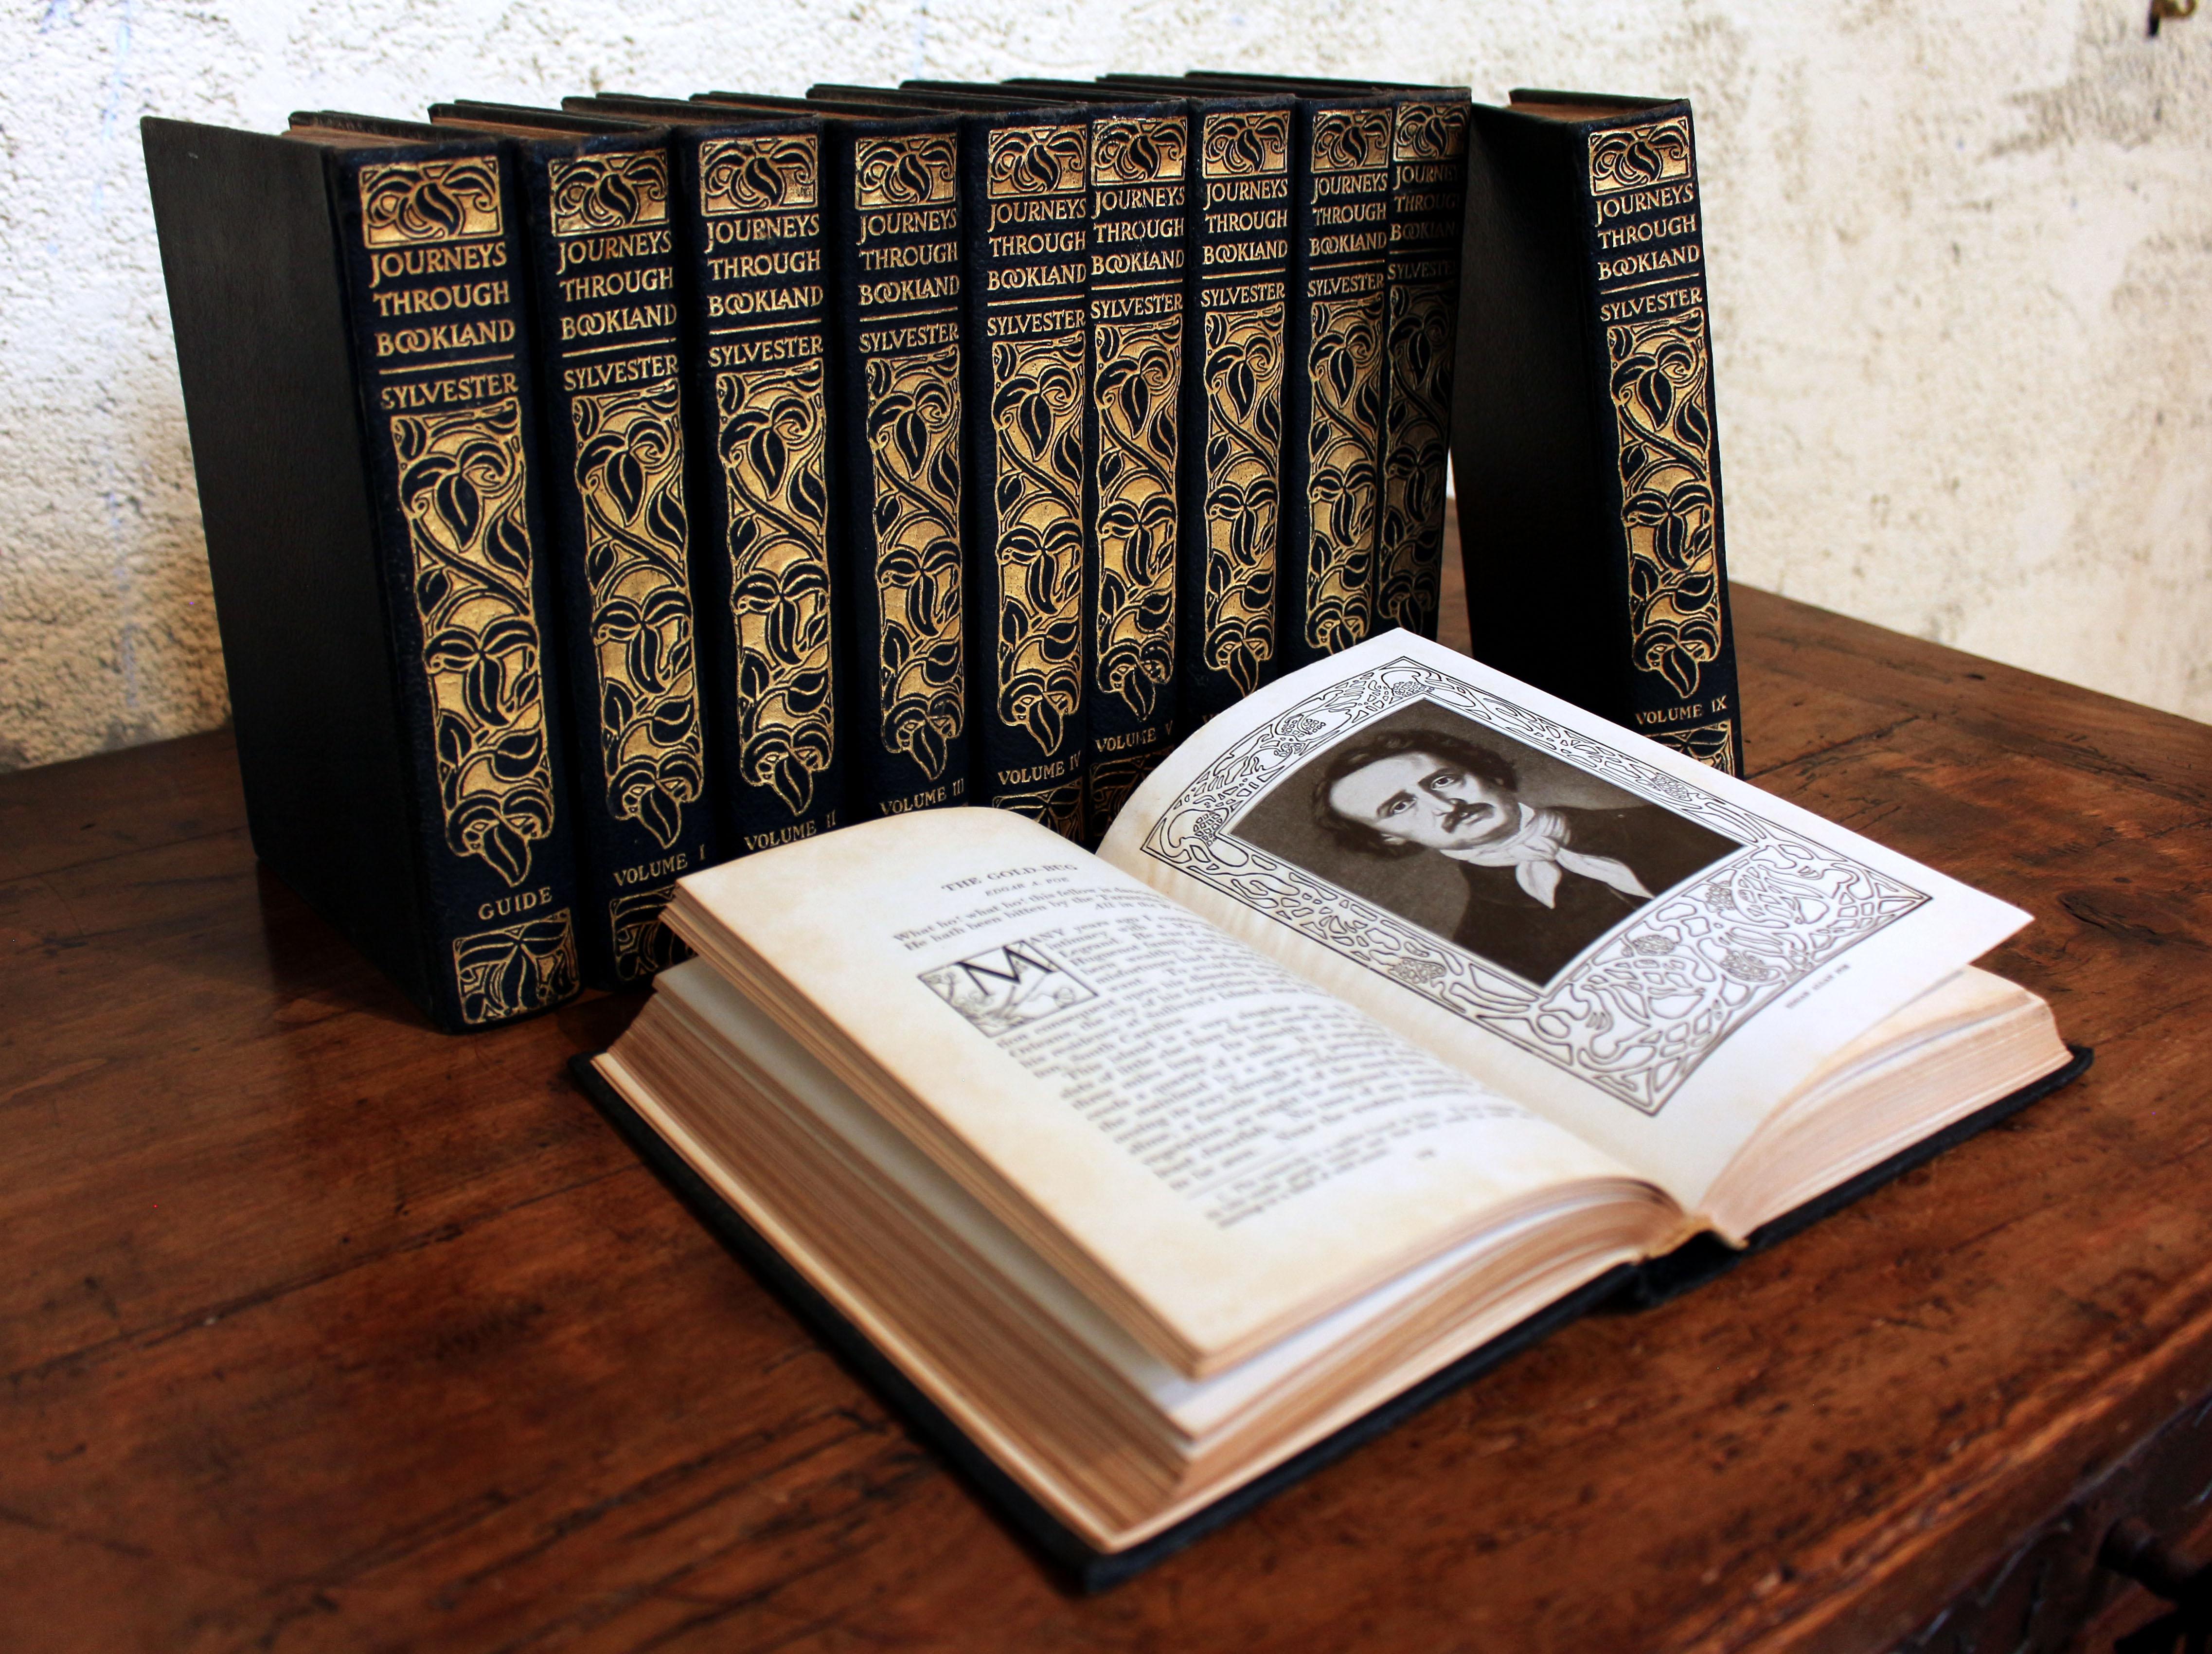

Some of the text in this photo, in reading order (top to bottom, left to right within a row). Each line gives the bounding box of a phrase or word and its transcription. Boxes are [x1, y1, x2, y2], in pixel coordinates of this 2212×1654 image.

[1091, 186, 1185, 219] JOURNEYS
[1203, 178, 1288, 210] JOURNEYS
[1311, 173, 1388, 204] JOURNEYS
[987, 198, 1087, 232] JOURNEYS
[1312, 202, 1387, 226] THROUGH
[1595, 183, 1695, 227] JOURNEYS
[703, 213, 820, 253] JOURNEYS
[856, 207, 957, 246] JOURNEYS
[1093, 217, 1184, 243] THROUGH
[1205, 209, 1288, 234] THROUGH
[1597, 214, 1697, 249] THROUGH
[556, 230, 672, 275] JOURNEYS
[858, 242, 958, 271] THROUGH
[989, 231, 1086, 257] THROUGH
[1202, 239, 1288, 265] BOOKLAND
[1309, 232, 1387, 256] BOOKLAND
[369, 241, 507, 288] JOURNEYS
[707, 249, 821, 281] THROUGH
[987, 264, 1087, 291] BOOKLAND
[1091, 250, 1184, 275] BOOKLAND
[1597, 245, 1700, 281] BOOKLAND
[373, 280, 511, 317] THROUGH
[559, 267, 674, 302] THROUGH
[858, 274, 960, 306] BOOKLAND
[1200, 282, 1285, 307] SYLVESTER
[1307, 273, 1384, 298] SYLVESTER
[707, 286, 823, 317] BOOKLAND
[1090, 293, 1183, 319] SYLVESTER
[1600, 288, 1702, 321] SYLVESTER
[560, 303, 677, 340] BOOKLAND
[858, 322, 959, 353] SYLVESTER
[987, 309, 1086, 336] SYLVESTER
[375, 319, 515, 357] BOOKLAND
[708, 335, 823, 367] SYLVESTER
[563, 354, 679, 391] SYLVESTER
[381, 372, 519, 410] SYLVESTER
[1635, 695, 1727, 724] VOLUME IX
[1095, 728, 1156, 752] VOLUME
[998, 750, 1081, 785] VOLUME IV
[879, 778, 964, 815] VOLUME III
[744, 809, 836, 850] VOLUME II
[613, 845, 706, 886] VOLUME I
[941, 878, 982, 891] THE
[985, 883, 1025, 896] EDGAR
[478, 886, 552, 920] GUIDE
[893, 926, 935, 941] What
[965, 906, 999, 918] what
[905, 941, 927, 951] He
[930, 928, 965, 942] hath
[966, 918, 1001, 929] been
[1004, 905, 1046, 918] bitten
